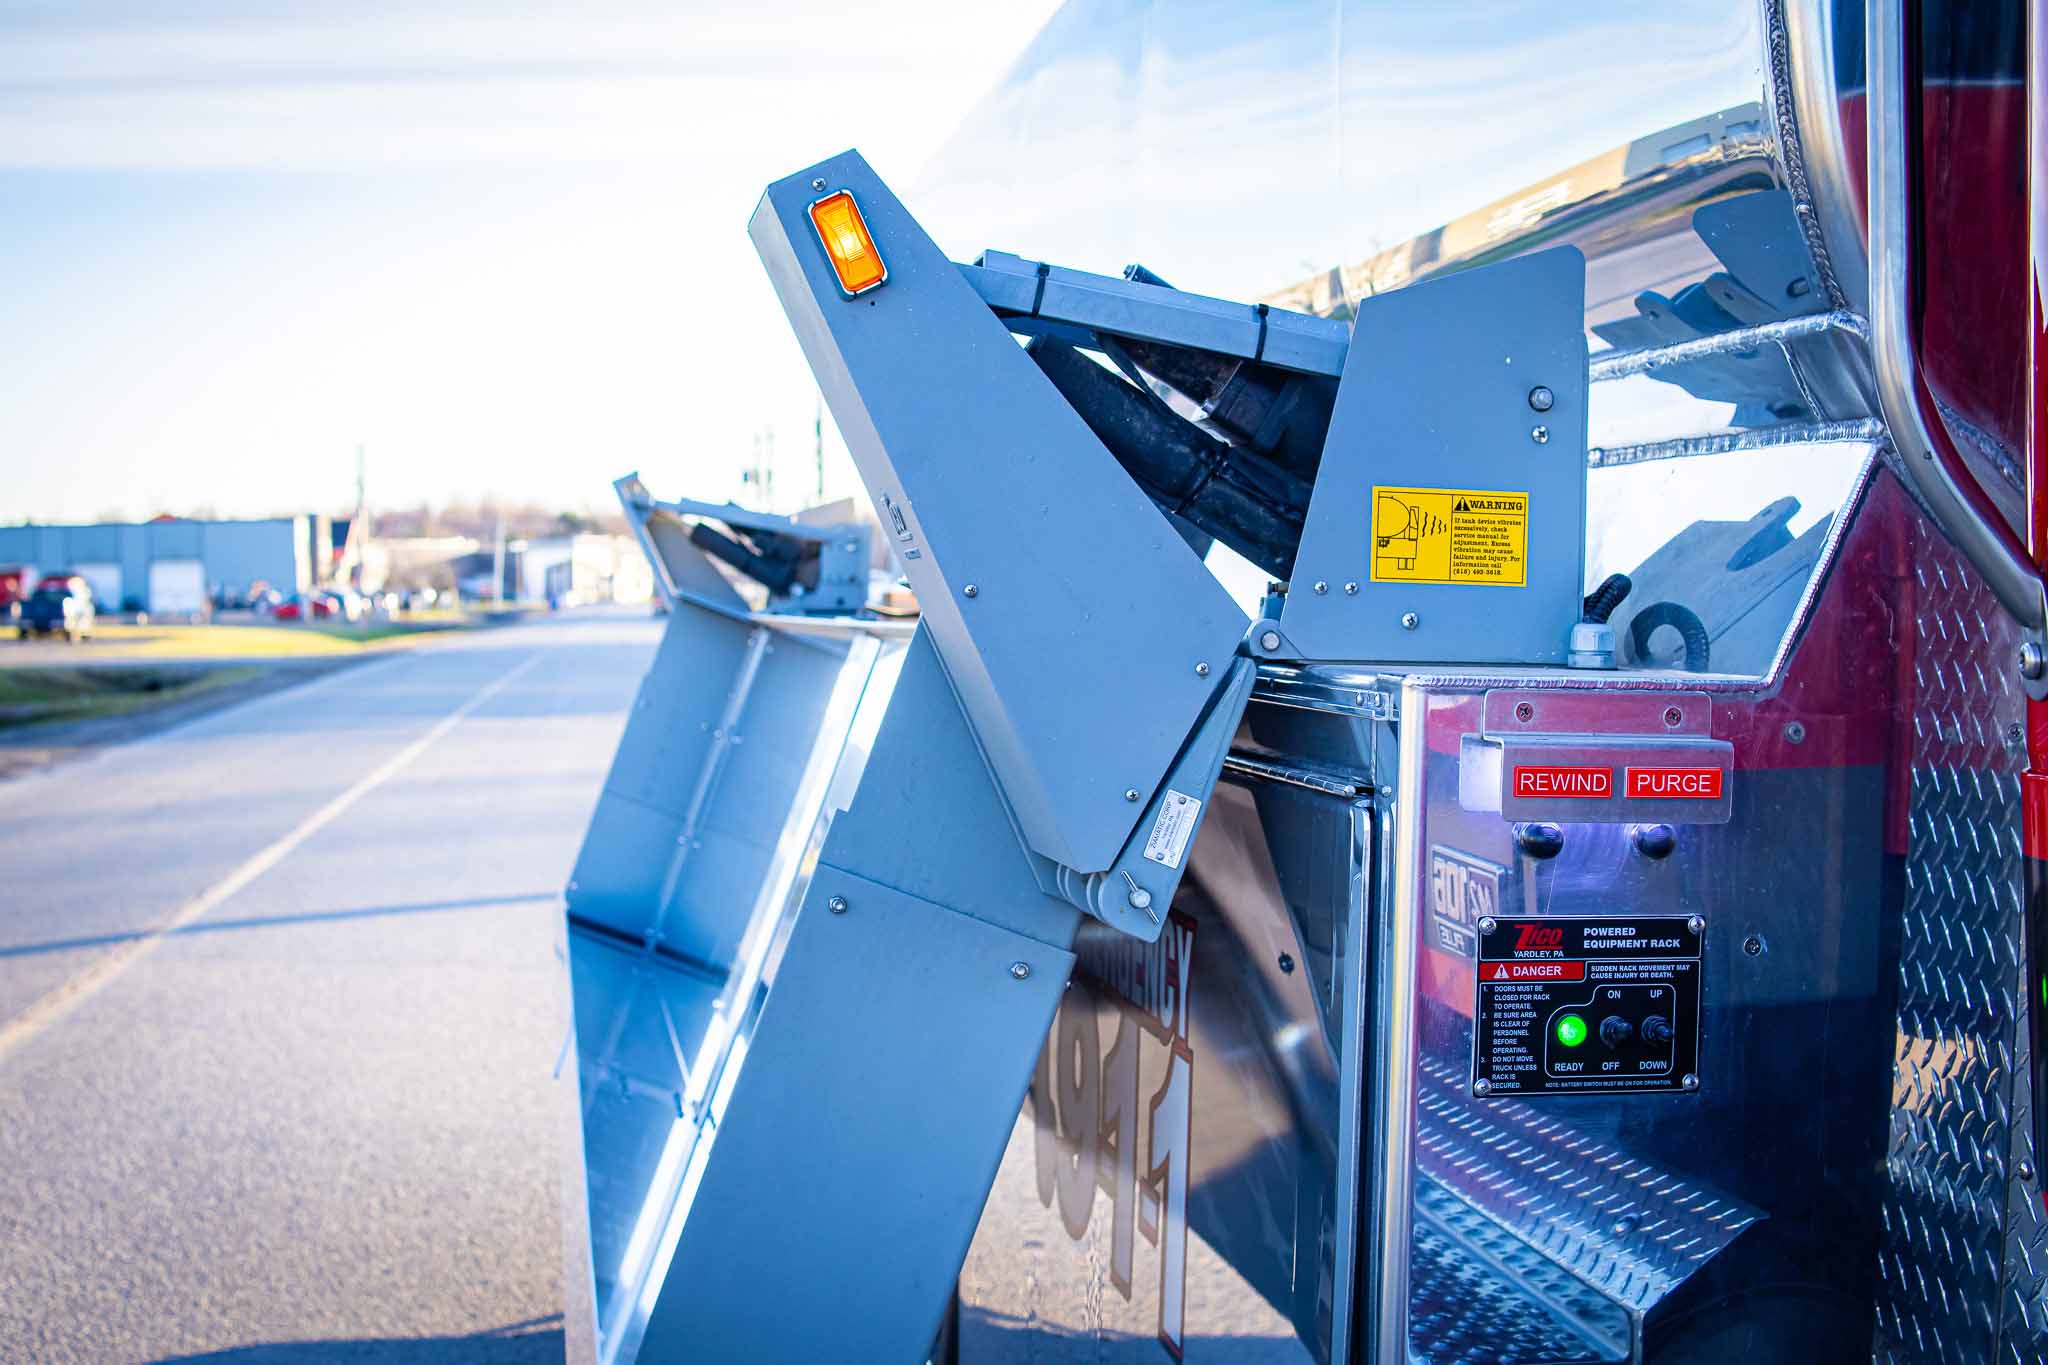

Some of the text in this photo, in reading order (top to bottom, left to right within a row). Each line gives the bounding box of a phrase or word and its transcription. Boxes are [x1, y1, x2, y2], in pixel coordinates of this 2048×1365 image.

[1470, 500, 1522, 510] WARNING
[1520, 773, 1607, 792] REWIND
[1638, 775, 1711, 792] PURGE
[1584, 928, 1636, 936] POWERED
[1584, 939, 1680, 948] EQUIPMENT RACK
[1513, 967, 1561, 977] DANGER
[1608, 990, 1620, 998] ON
[1650, 990, 1662, 998] UP
[1555, 1063, 1584, 1071] READY
[1602, 1062, 1620, 1070] OFF
